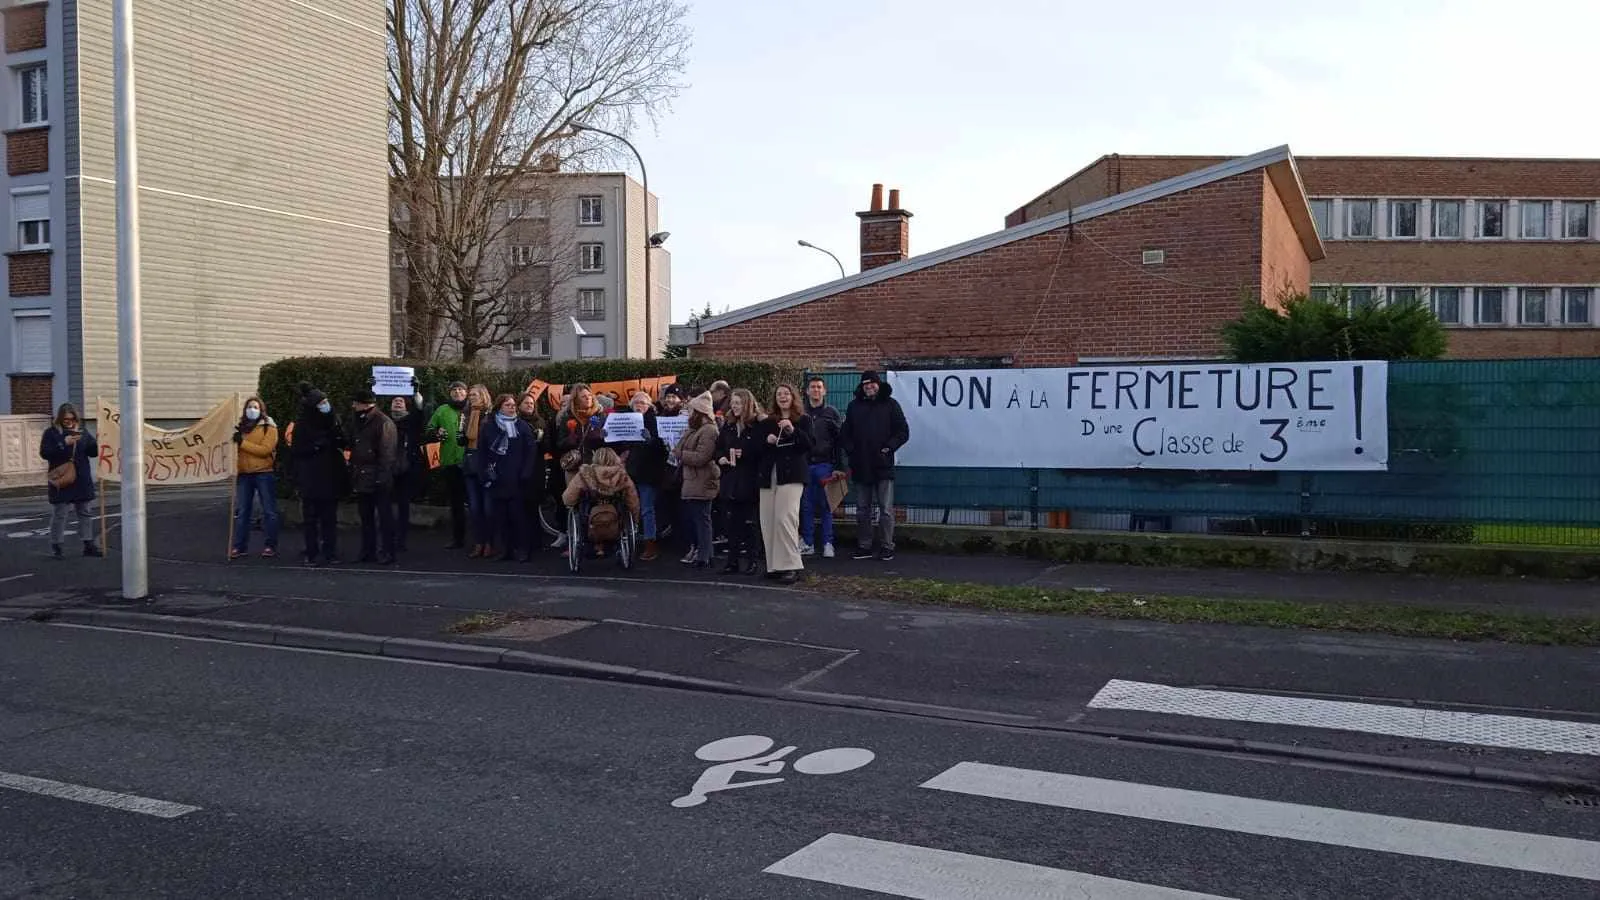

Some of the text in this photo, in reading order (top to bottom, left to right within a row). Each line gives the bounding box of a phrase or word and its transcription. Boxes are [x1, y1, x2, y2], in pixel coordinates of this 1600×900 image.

[918, 375, 992, 410] NON
[1006, 384, 1021, 409] À
[1029, 390, 1049, 409] LA
[1067, 366, 1335, 411] FERMETURE
[151, 434, 205, 450] DE LA
[1081, 416, 1123, 436] D'une
[1132, 416, 1216, 456] Classe
[1222, 432, 1245, 454] de
[98, 442, 229, 481] RISTANCE
